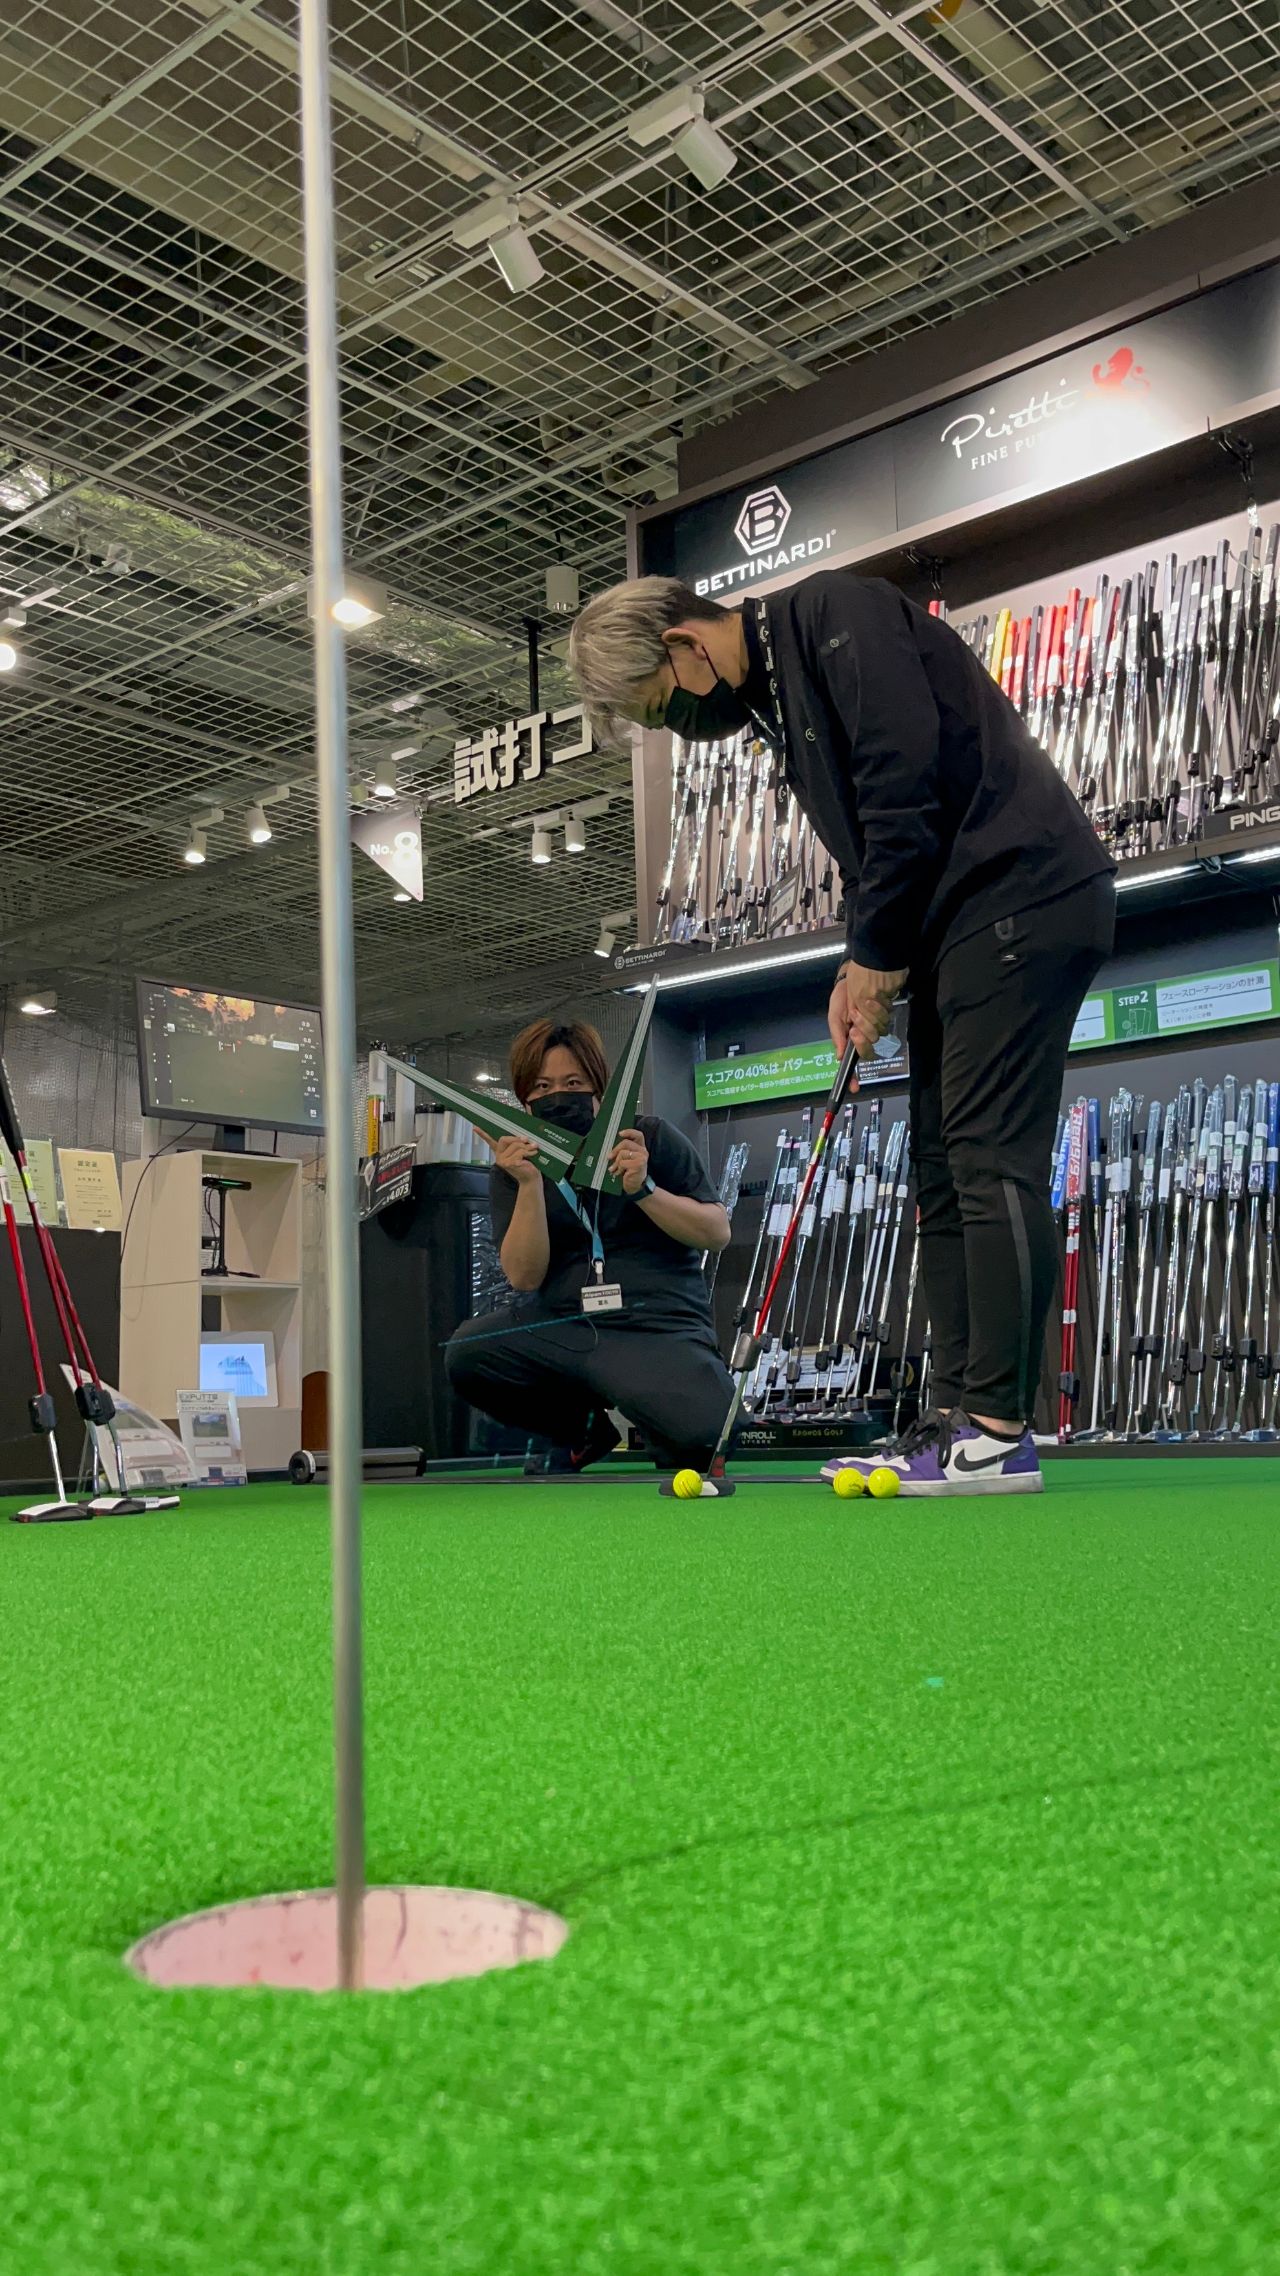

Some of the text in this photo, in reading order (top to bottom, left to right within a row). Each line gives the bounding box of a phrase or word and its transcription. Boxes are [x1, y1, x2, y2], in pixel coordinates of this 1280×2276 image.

[940, 378, 1079, 459] Piretti
[970, 446, 1008, 470] FINE
[695, 532, 832, 596] BETTINARDI
[1230, 804, 1280, 831] PING
